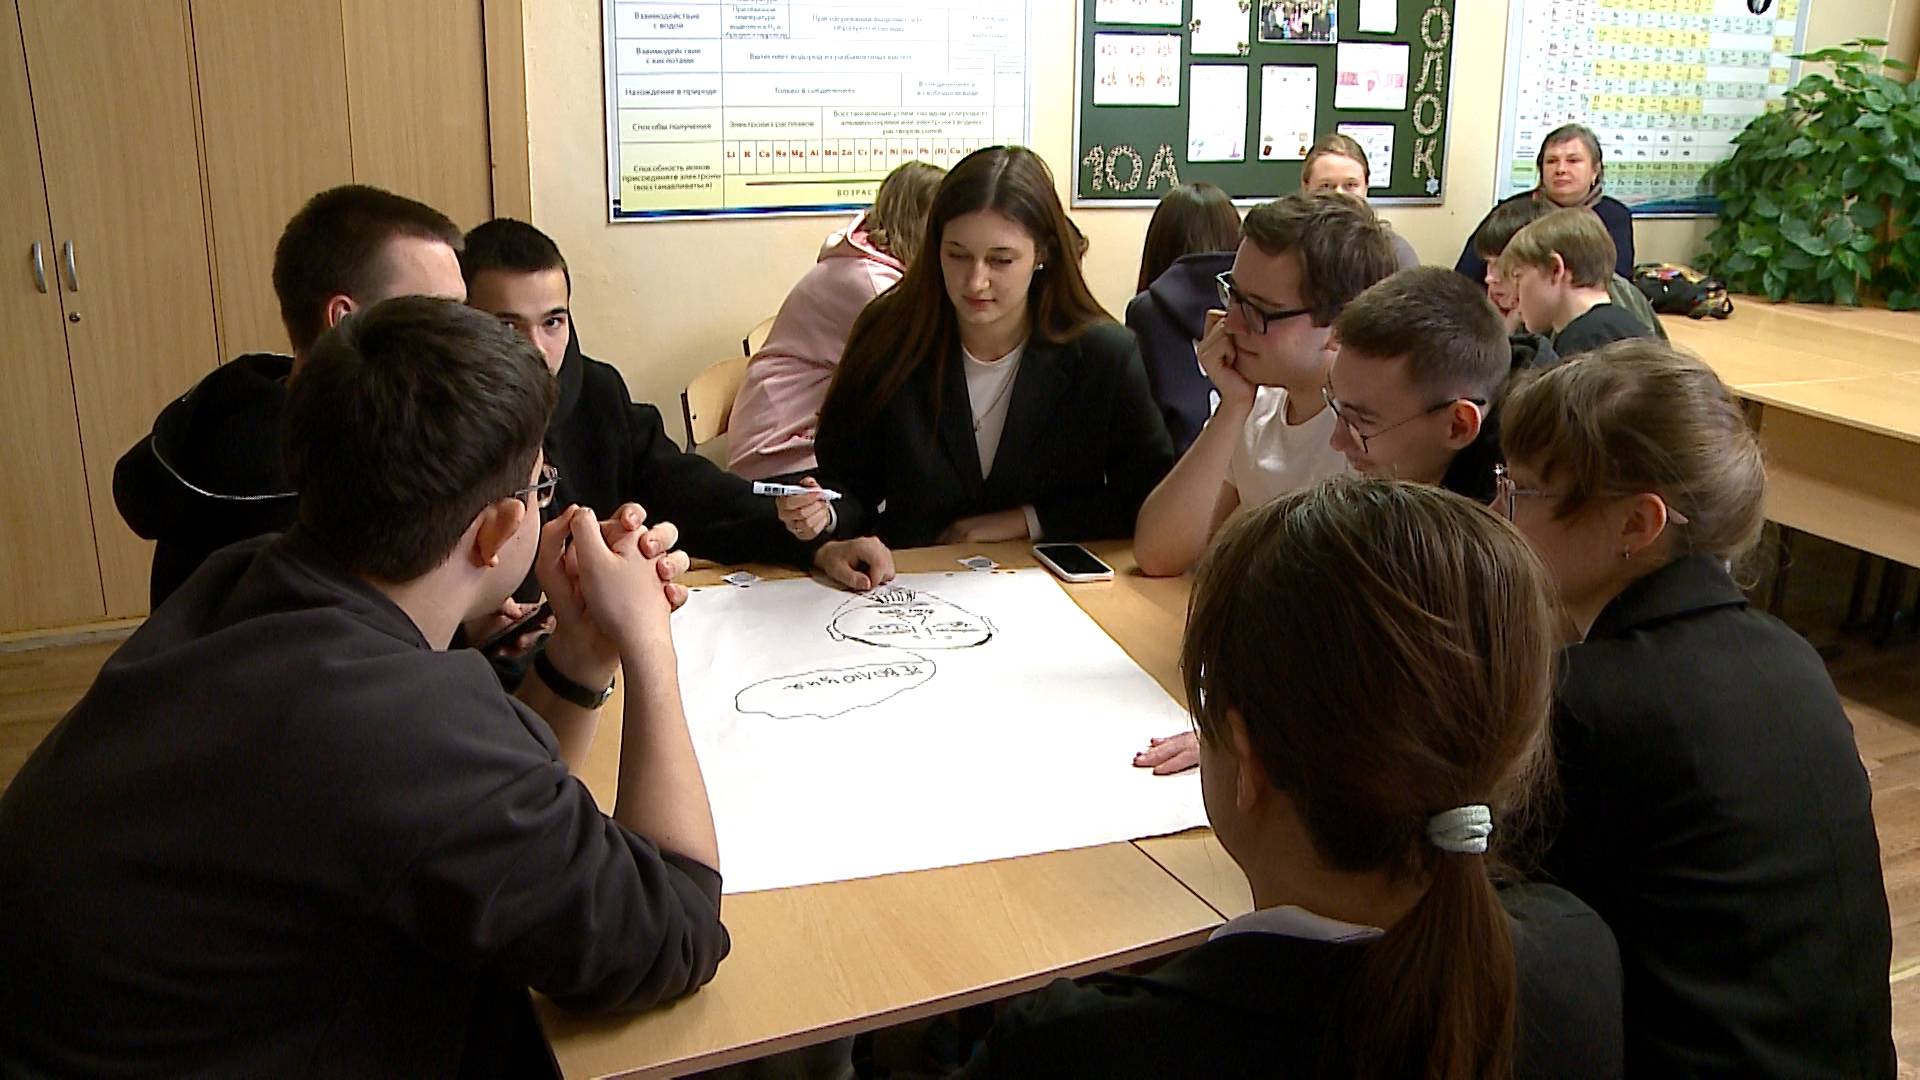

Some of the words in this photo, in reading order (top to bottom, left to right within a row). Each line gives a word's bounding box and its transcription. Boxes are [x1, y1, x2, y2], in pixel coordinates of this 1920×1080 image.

[1413, 0, 1451, 178] ОЛОК
[726, 150, 736, 158] Li
[743, 150, 751, 158] K
[759, 149, 771, 158] Ca
[775, 149, 787, 157] Na
[791, 149, 804, 158] Mg
[810, 149, 819, 157] Al
[889, 148, 899, 156] Ni
[949, 147, 961, 155] Cu
